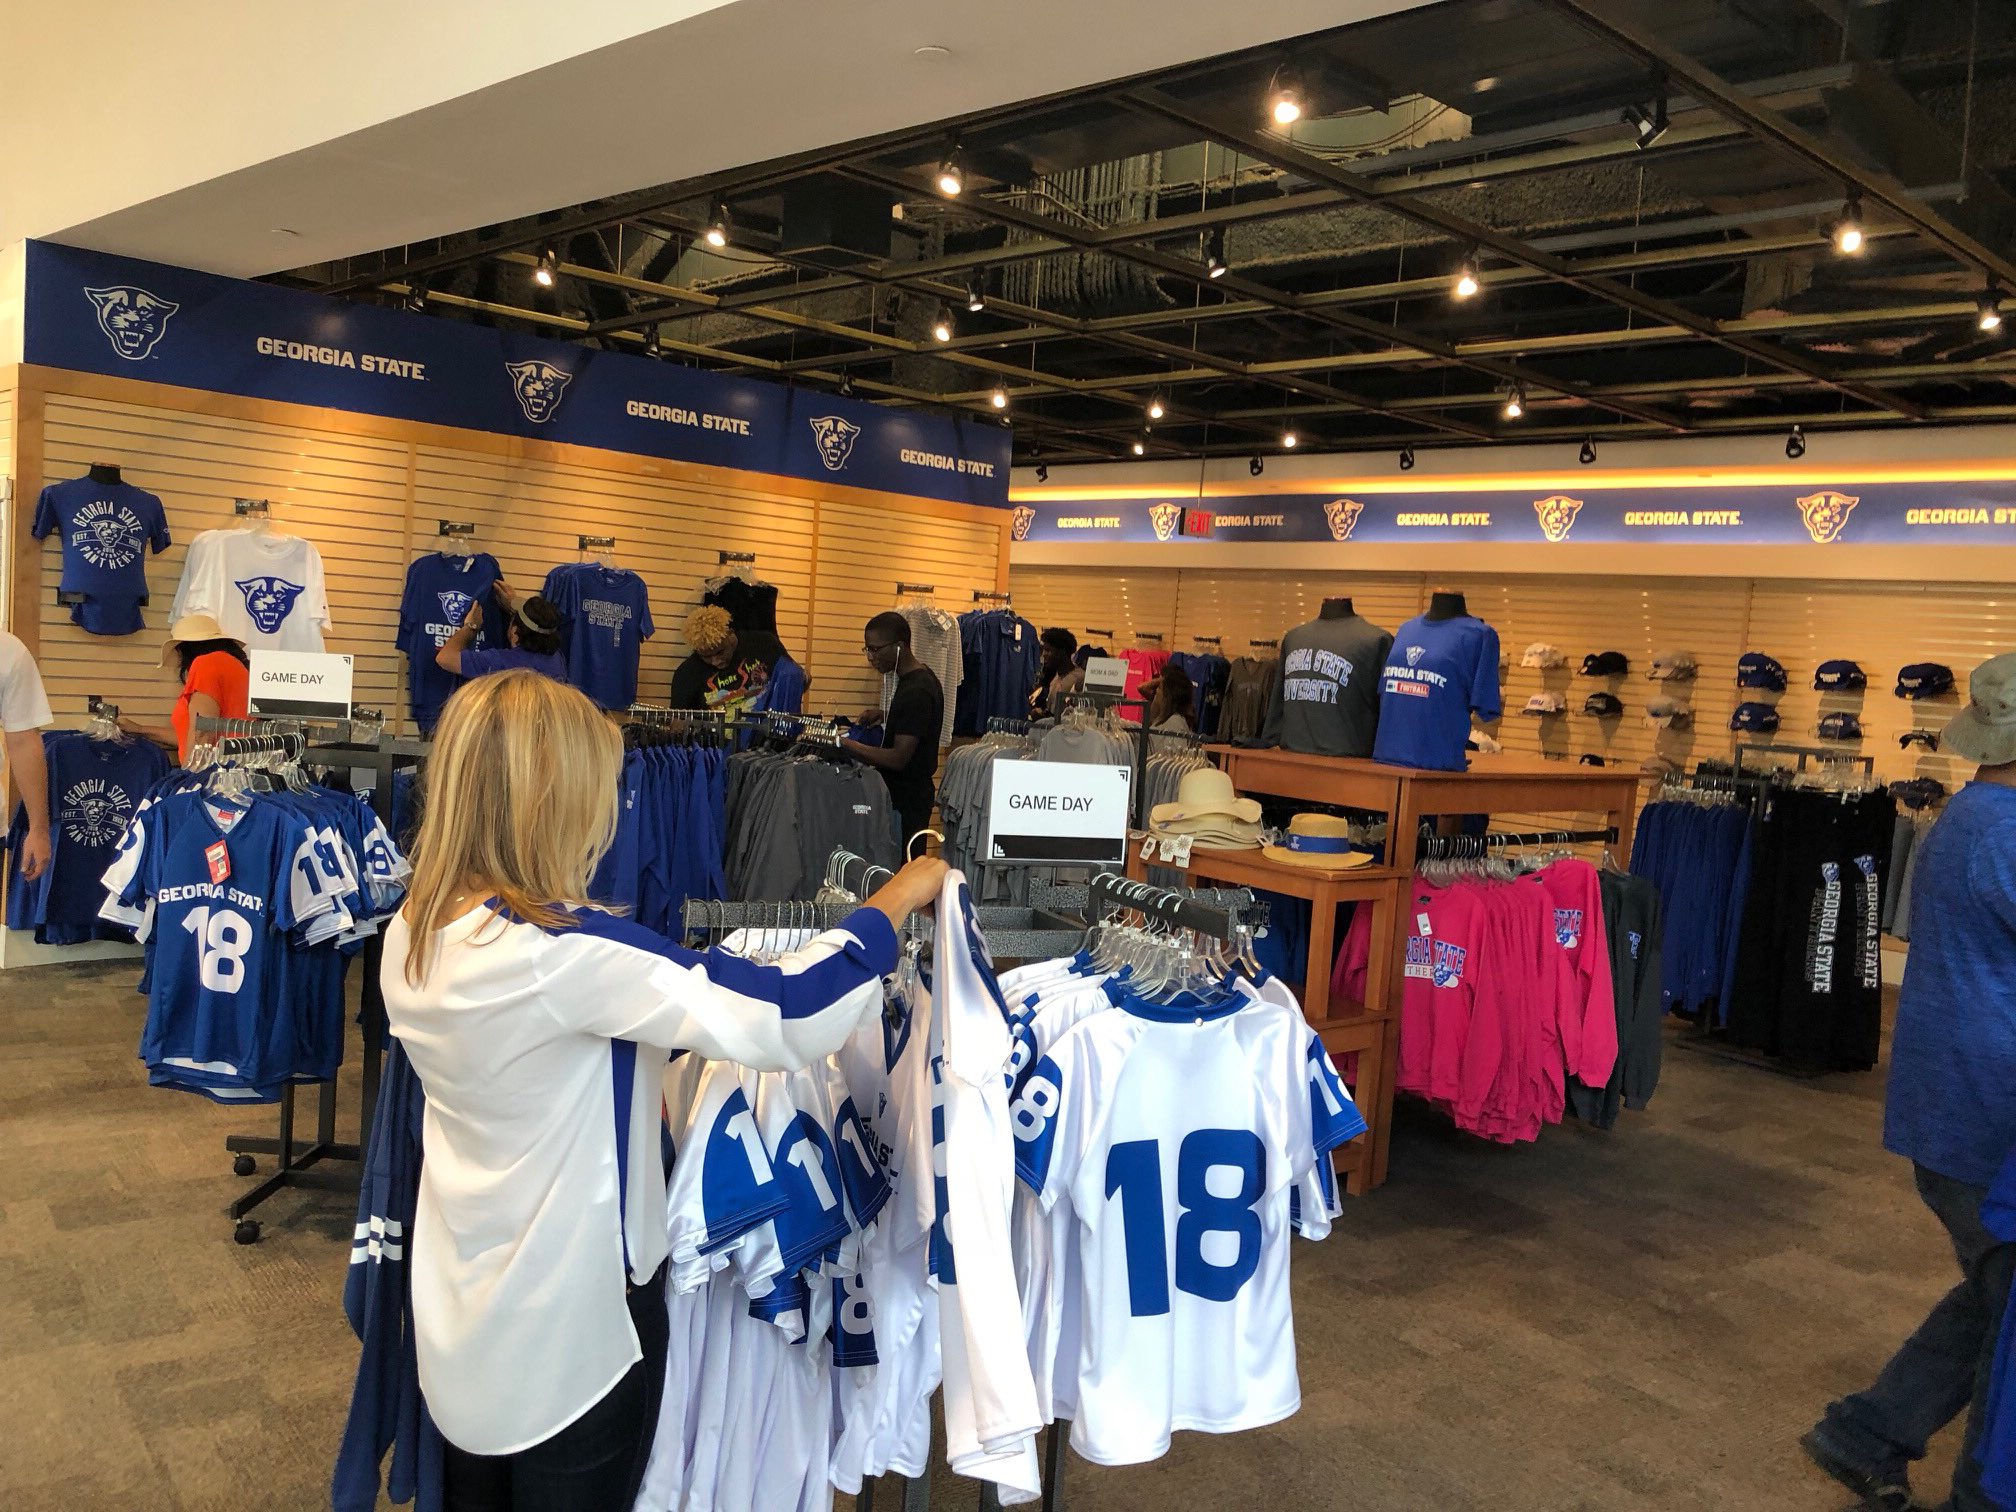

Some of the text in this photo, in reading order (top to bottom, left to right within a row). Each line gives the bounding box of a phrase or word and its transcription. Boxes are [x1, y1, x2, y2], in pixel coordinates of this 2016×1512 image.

[257, 337, 425, 380] GEORGIA STATE
[626, 400, 750, 436] GEORGIA STATE
[900, 448, 994, 478] GEORGIA STATE
[73, 501, 143, 533] GEORGIA STATE
[1057, 516, 1120, 528] GEORGIA STATE
[1189, 510, 1212, 535] EXIT
[1215, 515, 1284, 527] EORGIA STATE
[1396, 512, 1490, 526] GEORGIA STATE
[1625, 511, 1740, 525] GEORGIA STATE
[1906, 508, 1989, 524] GEORGIA
[80, 546, 135, 570] PANTHERS
[583, 599, 632, 619] GEORGIA
[588, 613, 624, 630] STATE
[261, 671, 324, 684] GAME DAY
[1313, 649, 1354, 687] STATE
[1416, 669, 1447, 688] STATE
[64, 779, 132, 811] GEORGIA STATE
[1009, 794, 1093, 812] GAME DAY
[66, 824, 117, 847] PANTHERS
[1812, 881, 1841, 994] GEORGIA STATE
[1863, 873, 1878, 988] GEORGIA STATE
[181, 905, 253, 994] 18
[1434, 940, 1466, 976] TATE
[1105, 1128, 1266, 1317] 18
